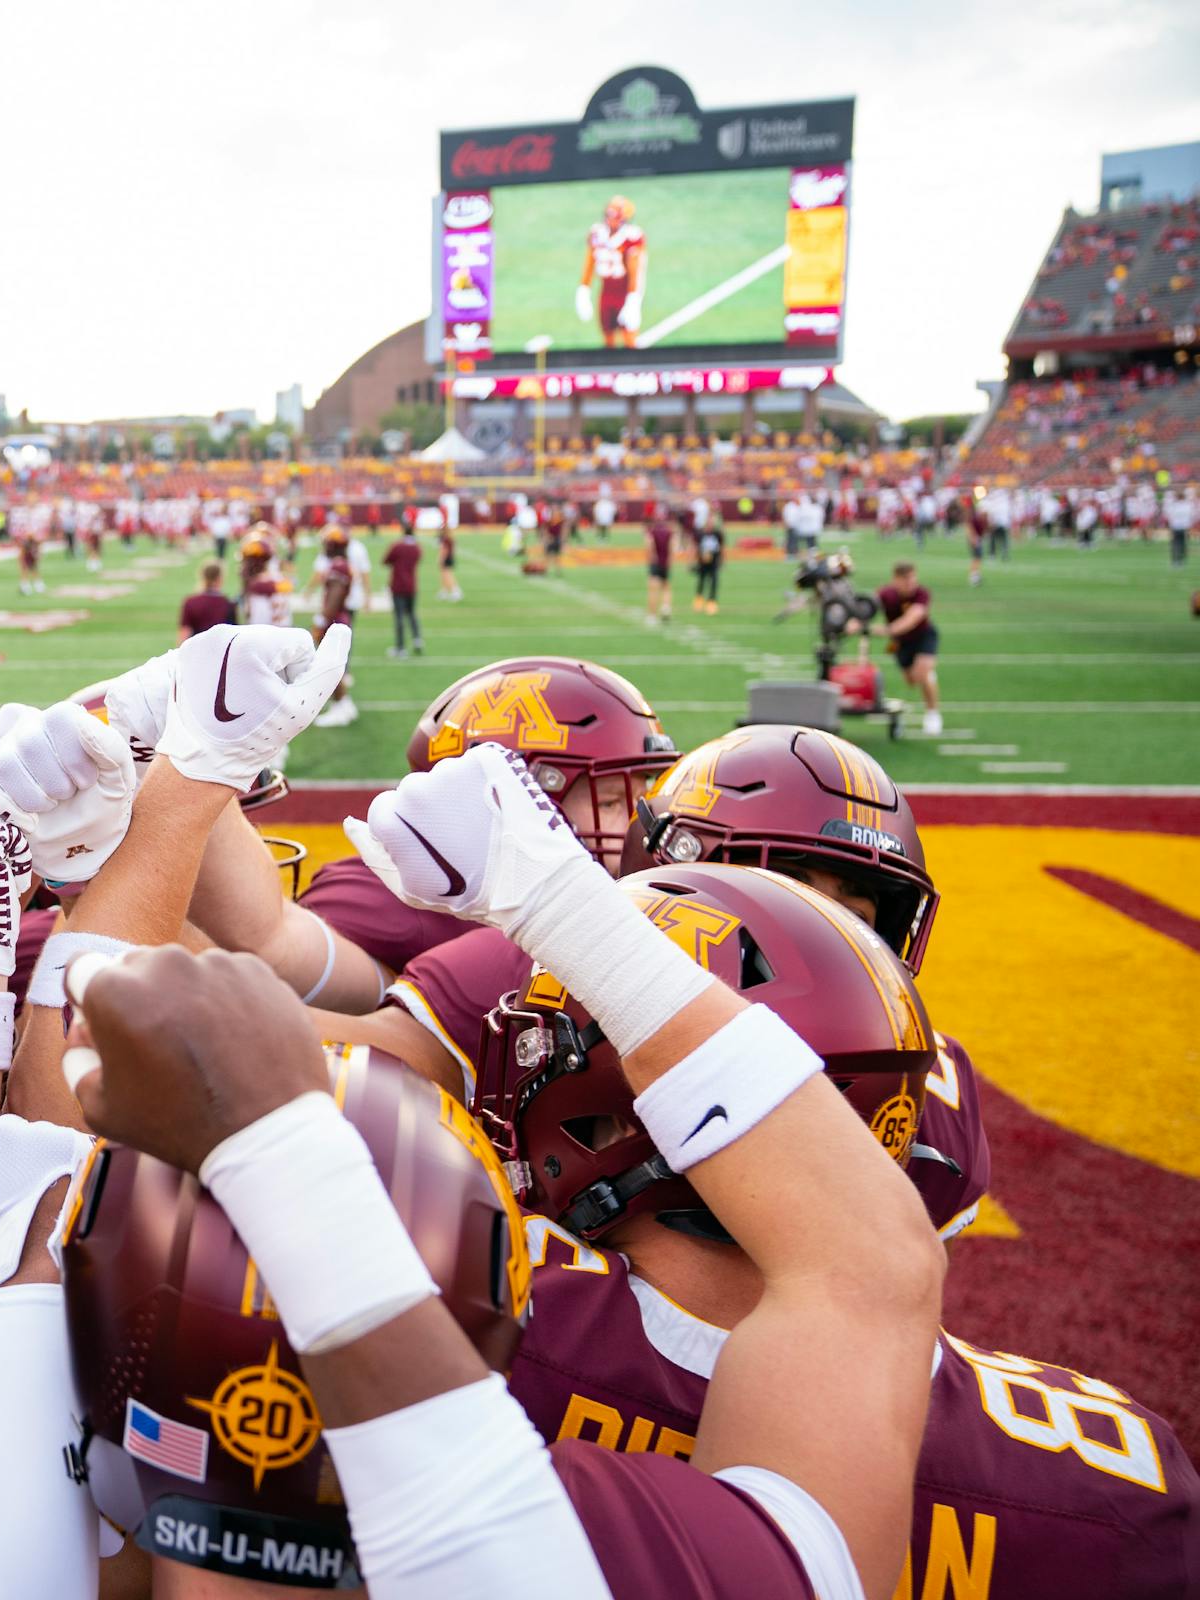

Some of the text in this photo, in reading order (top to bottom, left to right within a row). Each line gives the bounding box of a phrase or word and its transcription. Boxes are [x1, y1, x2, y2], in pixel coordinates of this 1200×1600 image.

[750, 117, 807, 137] United
[750, 132, 840, 156] Healthcare
[428, 673, 569, 763] M
[852, 826, 890, 850] ROW
[238, 1396, 292, 1441] 20
[155, 1515, 344, 1578] SKI-U-MAH
